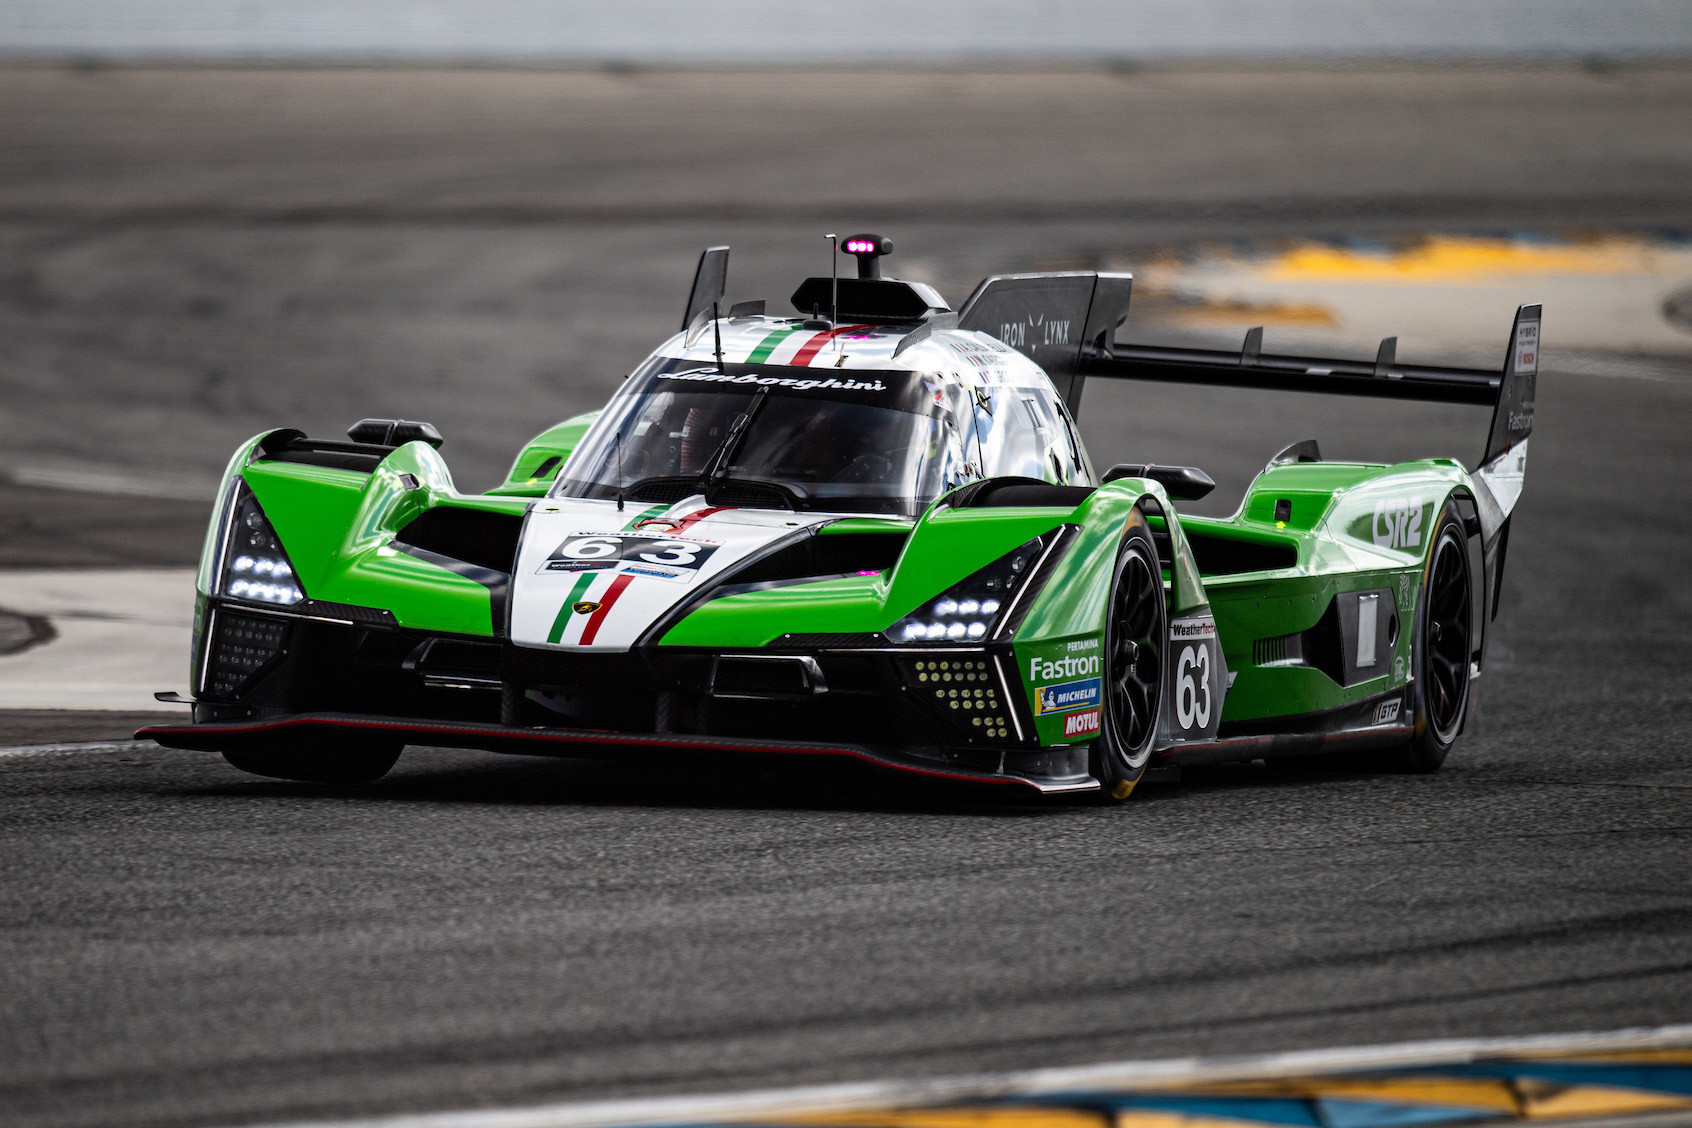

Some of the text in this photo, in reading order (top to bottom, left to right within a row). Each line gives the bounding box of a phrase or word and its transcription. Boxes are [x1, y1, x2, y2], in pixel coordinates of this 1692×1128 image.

[1000, 320, 1070, 347] IRON LYNX
[657, 367, 887, 392] Lamborghini
[1372, 496, 1423, 549] CSR2
[562, 537, 701, 565] 63
[1173, 623, 1216, 636] WeatherTech
[1067, 639, 1099, 652] PERTAMINA
[1030, 655, 1099, 681] Fastron
[1057, 687, 1097, 703] MICHELIN
[1176, 643, 1211, 729] 63
[1065, 711, 1099, 734] MOTUL
